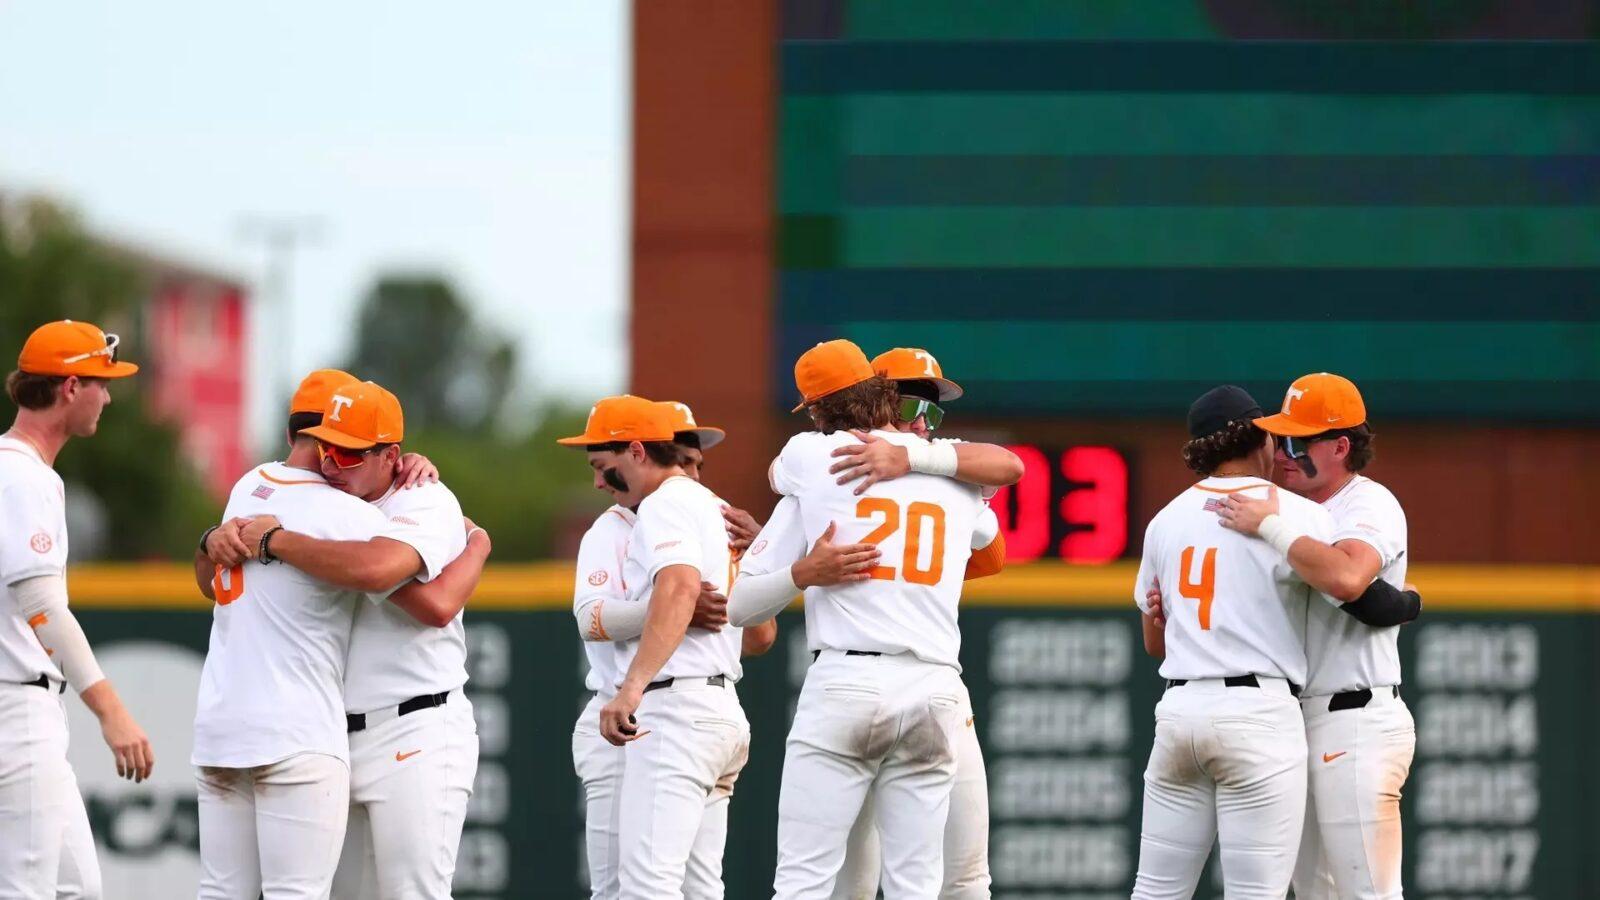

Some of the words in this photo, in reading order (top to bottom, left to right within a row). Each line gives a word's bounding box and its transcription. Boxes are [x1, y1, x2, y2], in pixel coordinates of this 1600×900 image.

[914, 350, 939, 378] T
[330, 394, 354, 422] T
[1280, 384, 1304, 415] T
[856, 497, 946, 587] 20
[1178, 546, 1218, 631] 4
